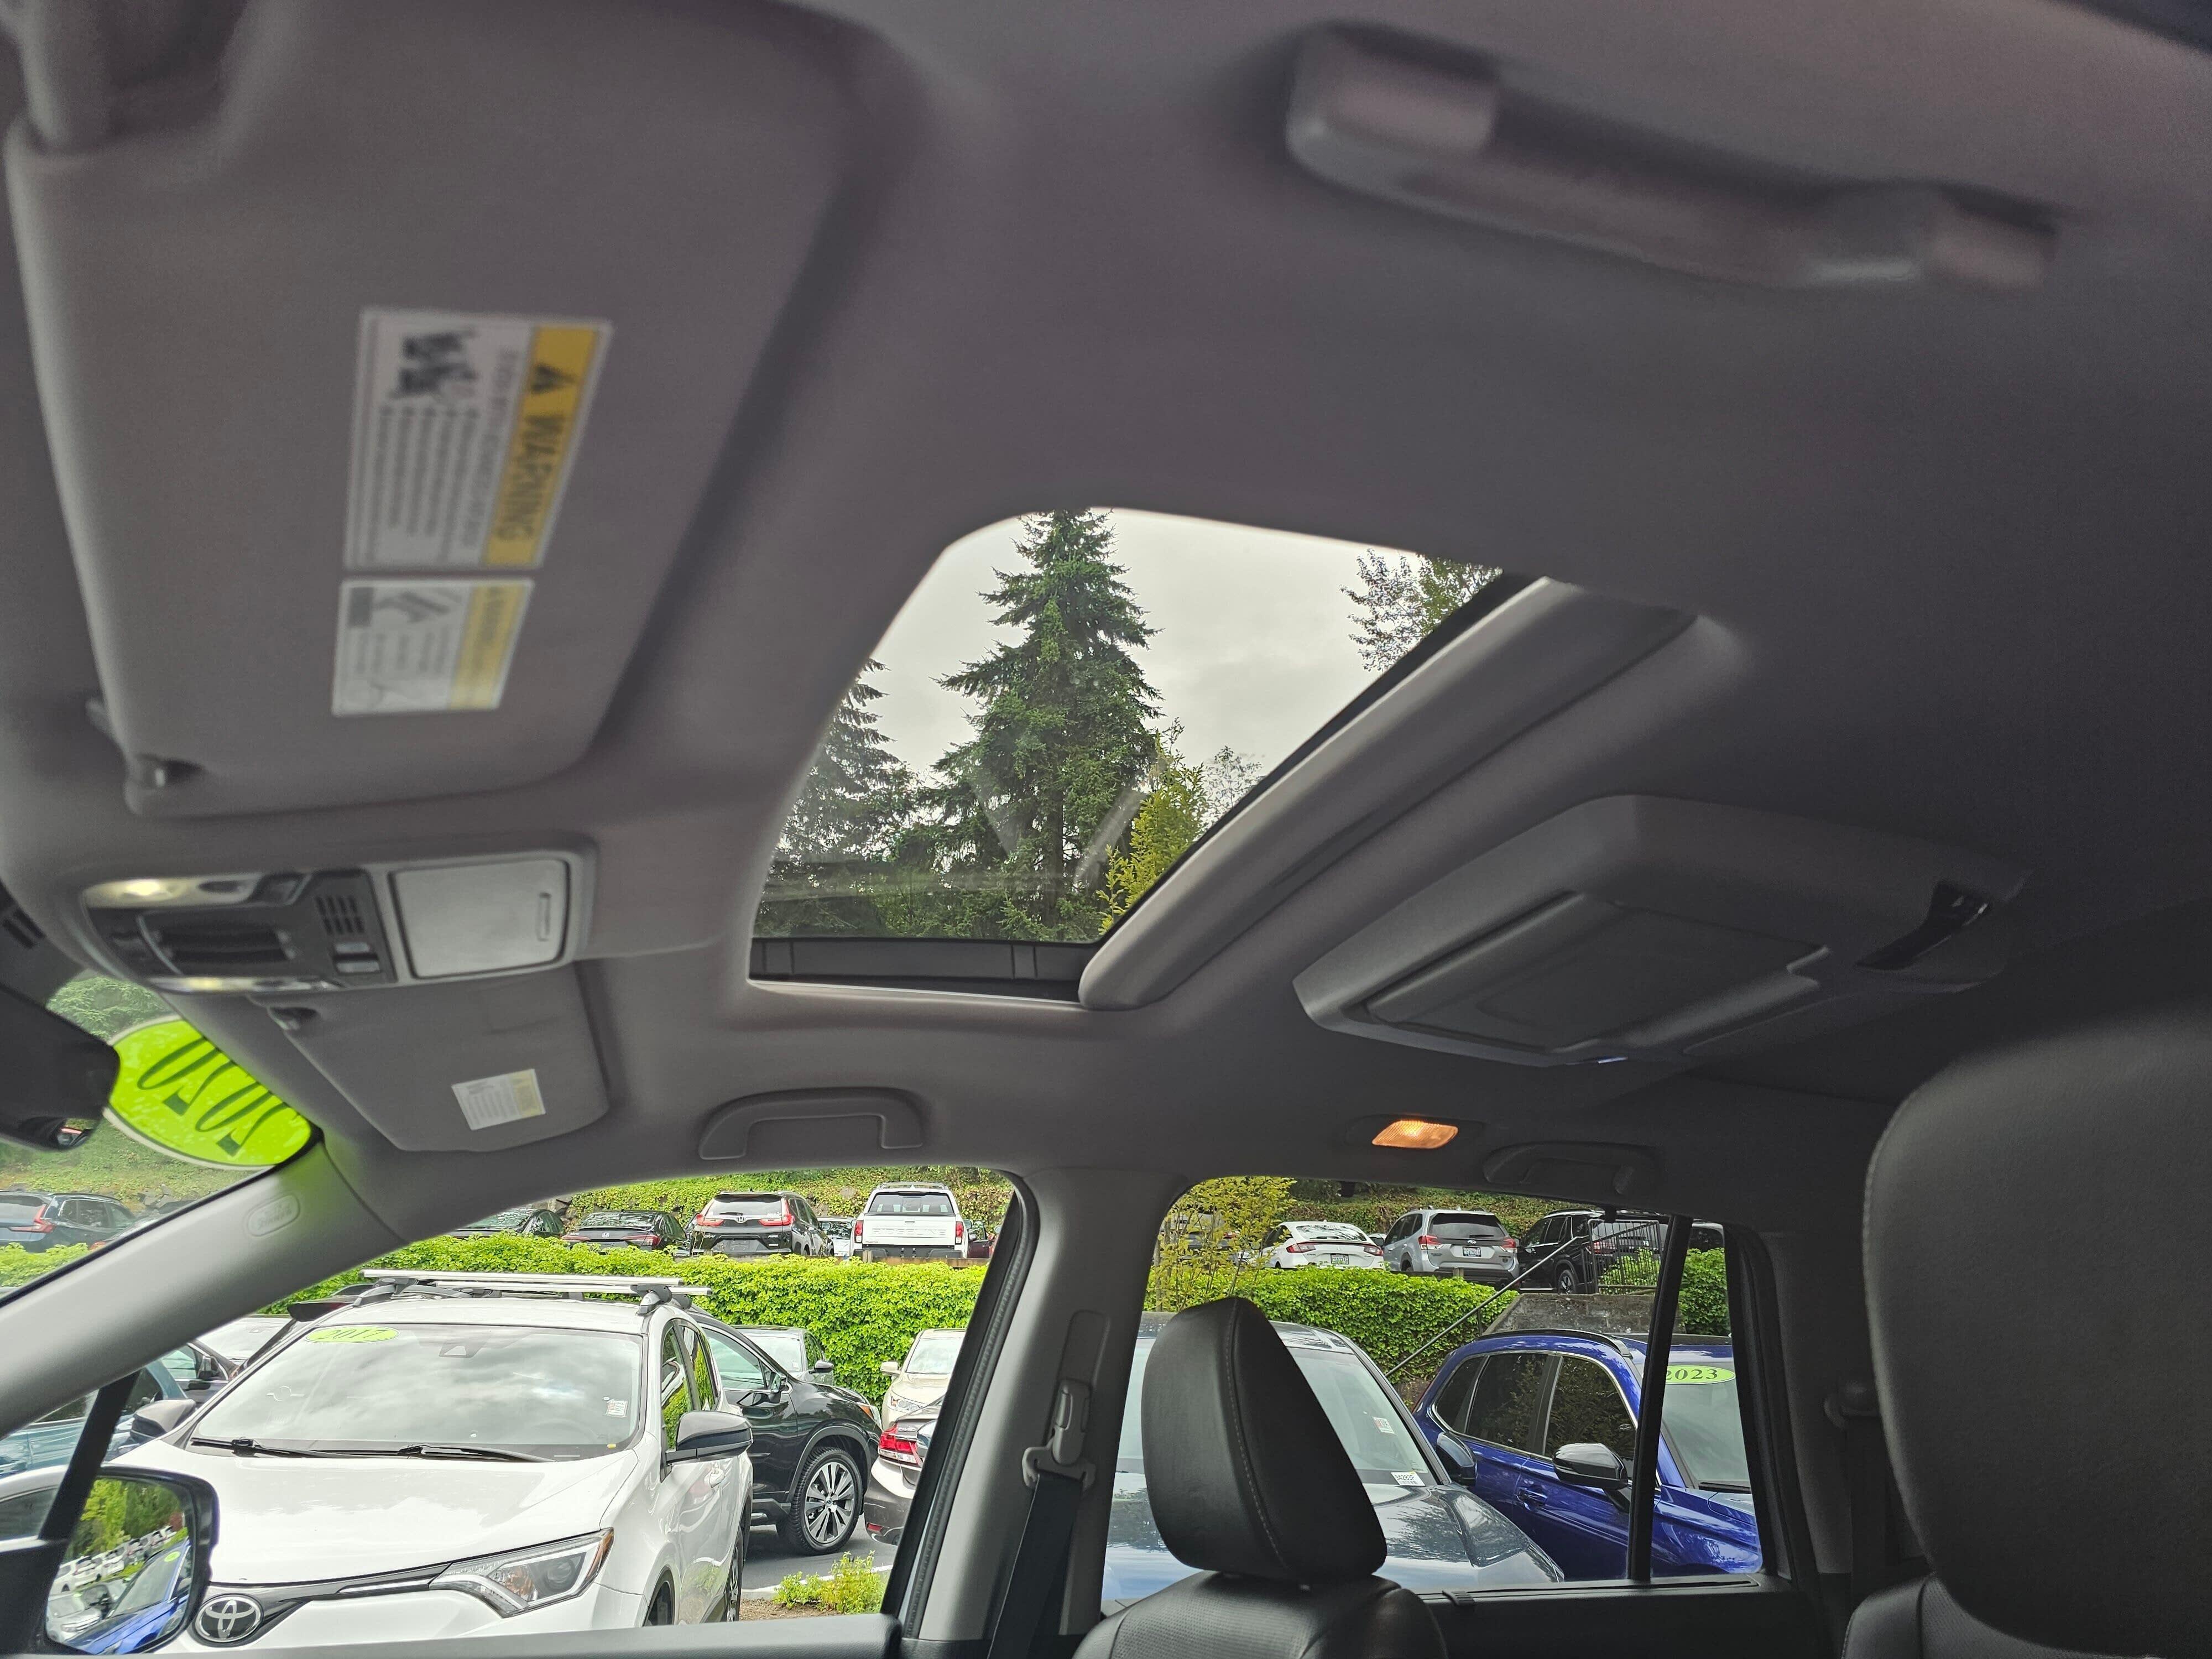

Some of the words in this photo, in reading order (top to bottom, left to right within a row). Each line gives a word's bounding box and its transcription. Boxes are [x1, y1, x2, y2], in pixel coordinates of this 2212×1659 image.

[495, 413, 565, 542] WARNING
[315, 1329, 389, 1340] 2017
[1666, 1369, 1718, 1380] 2023
